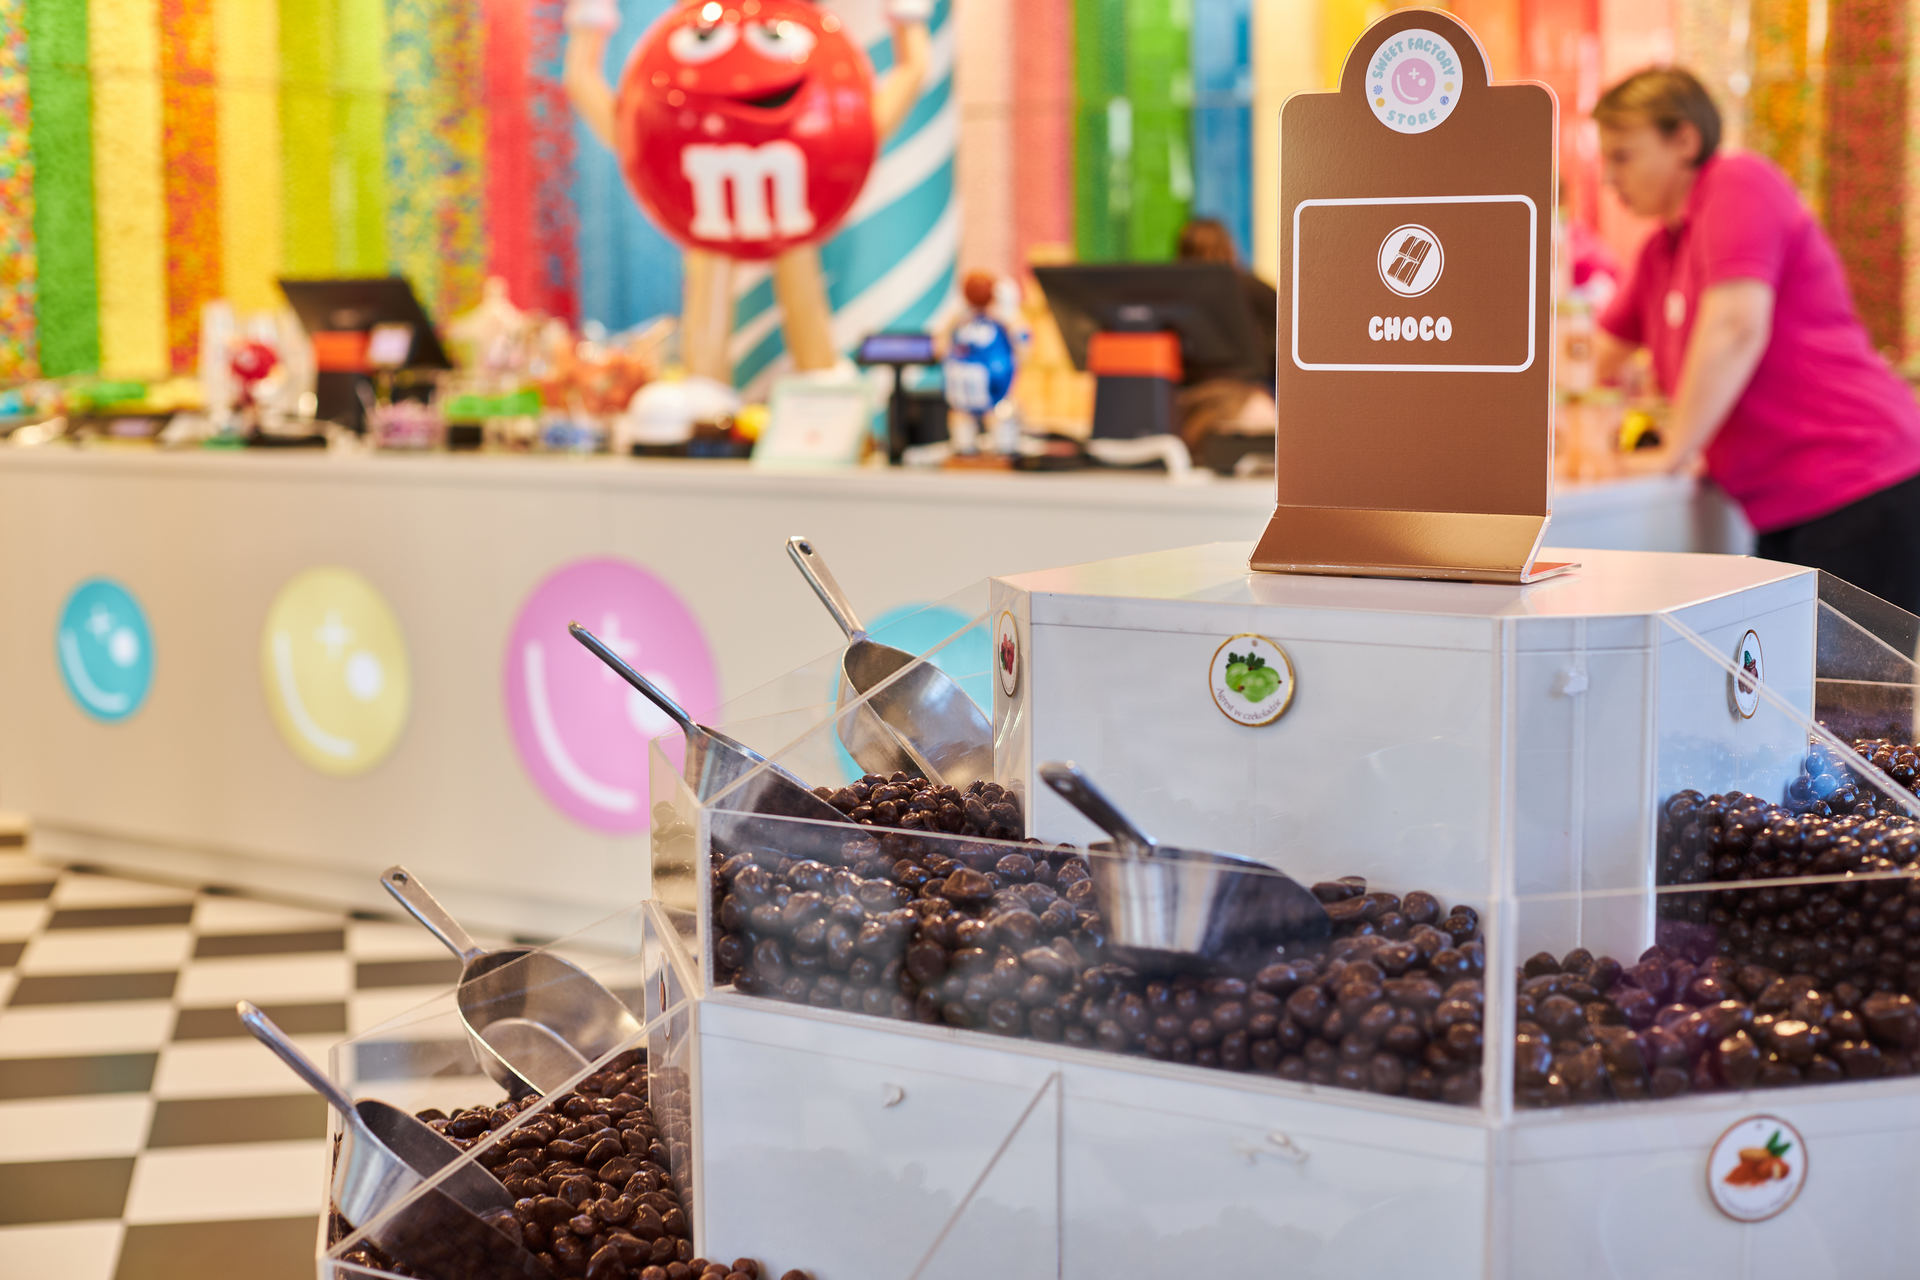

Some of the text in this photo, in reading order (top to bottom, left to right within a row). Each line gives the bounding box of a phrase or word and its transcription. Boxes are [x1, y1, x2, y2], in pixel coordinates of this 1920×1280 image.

[1372, 37, 1456, 79] SWEET FACTORY
[1386, 108, 1437, 126] STORE
[681, 139, 816, 241] m
[1368, 315, 1453, 342] CHOCO
